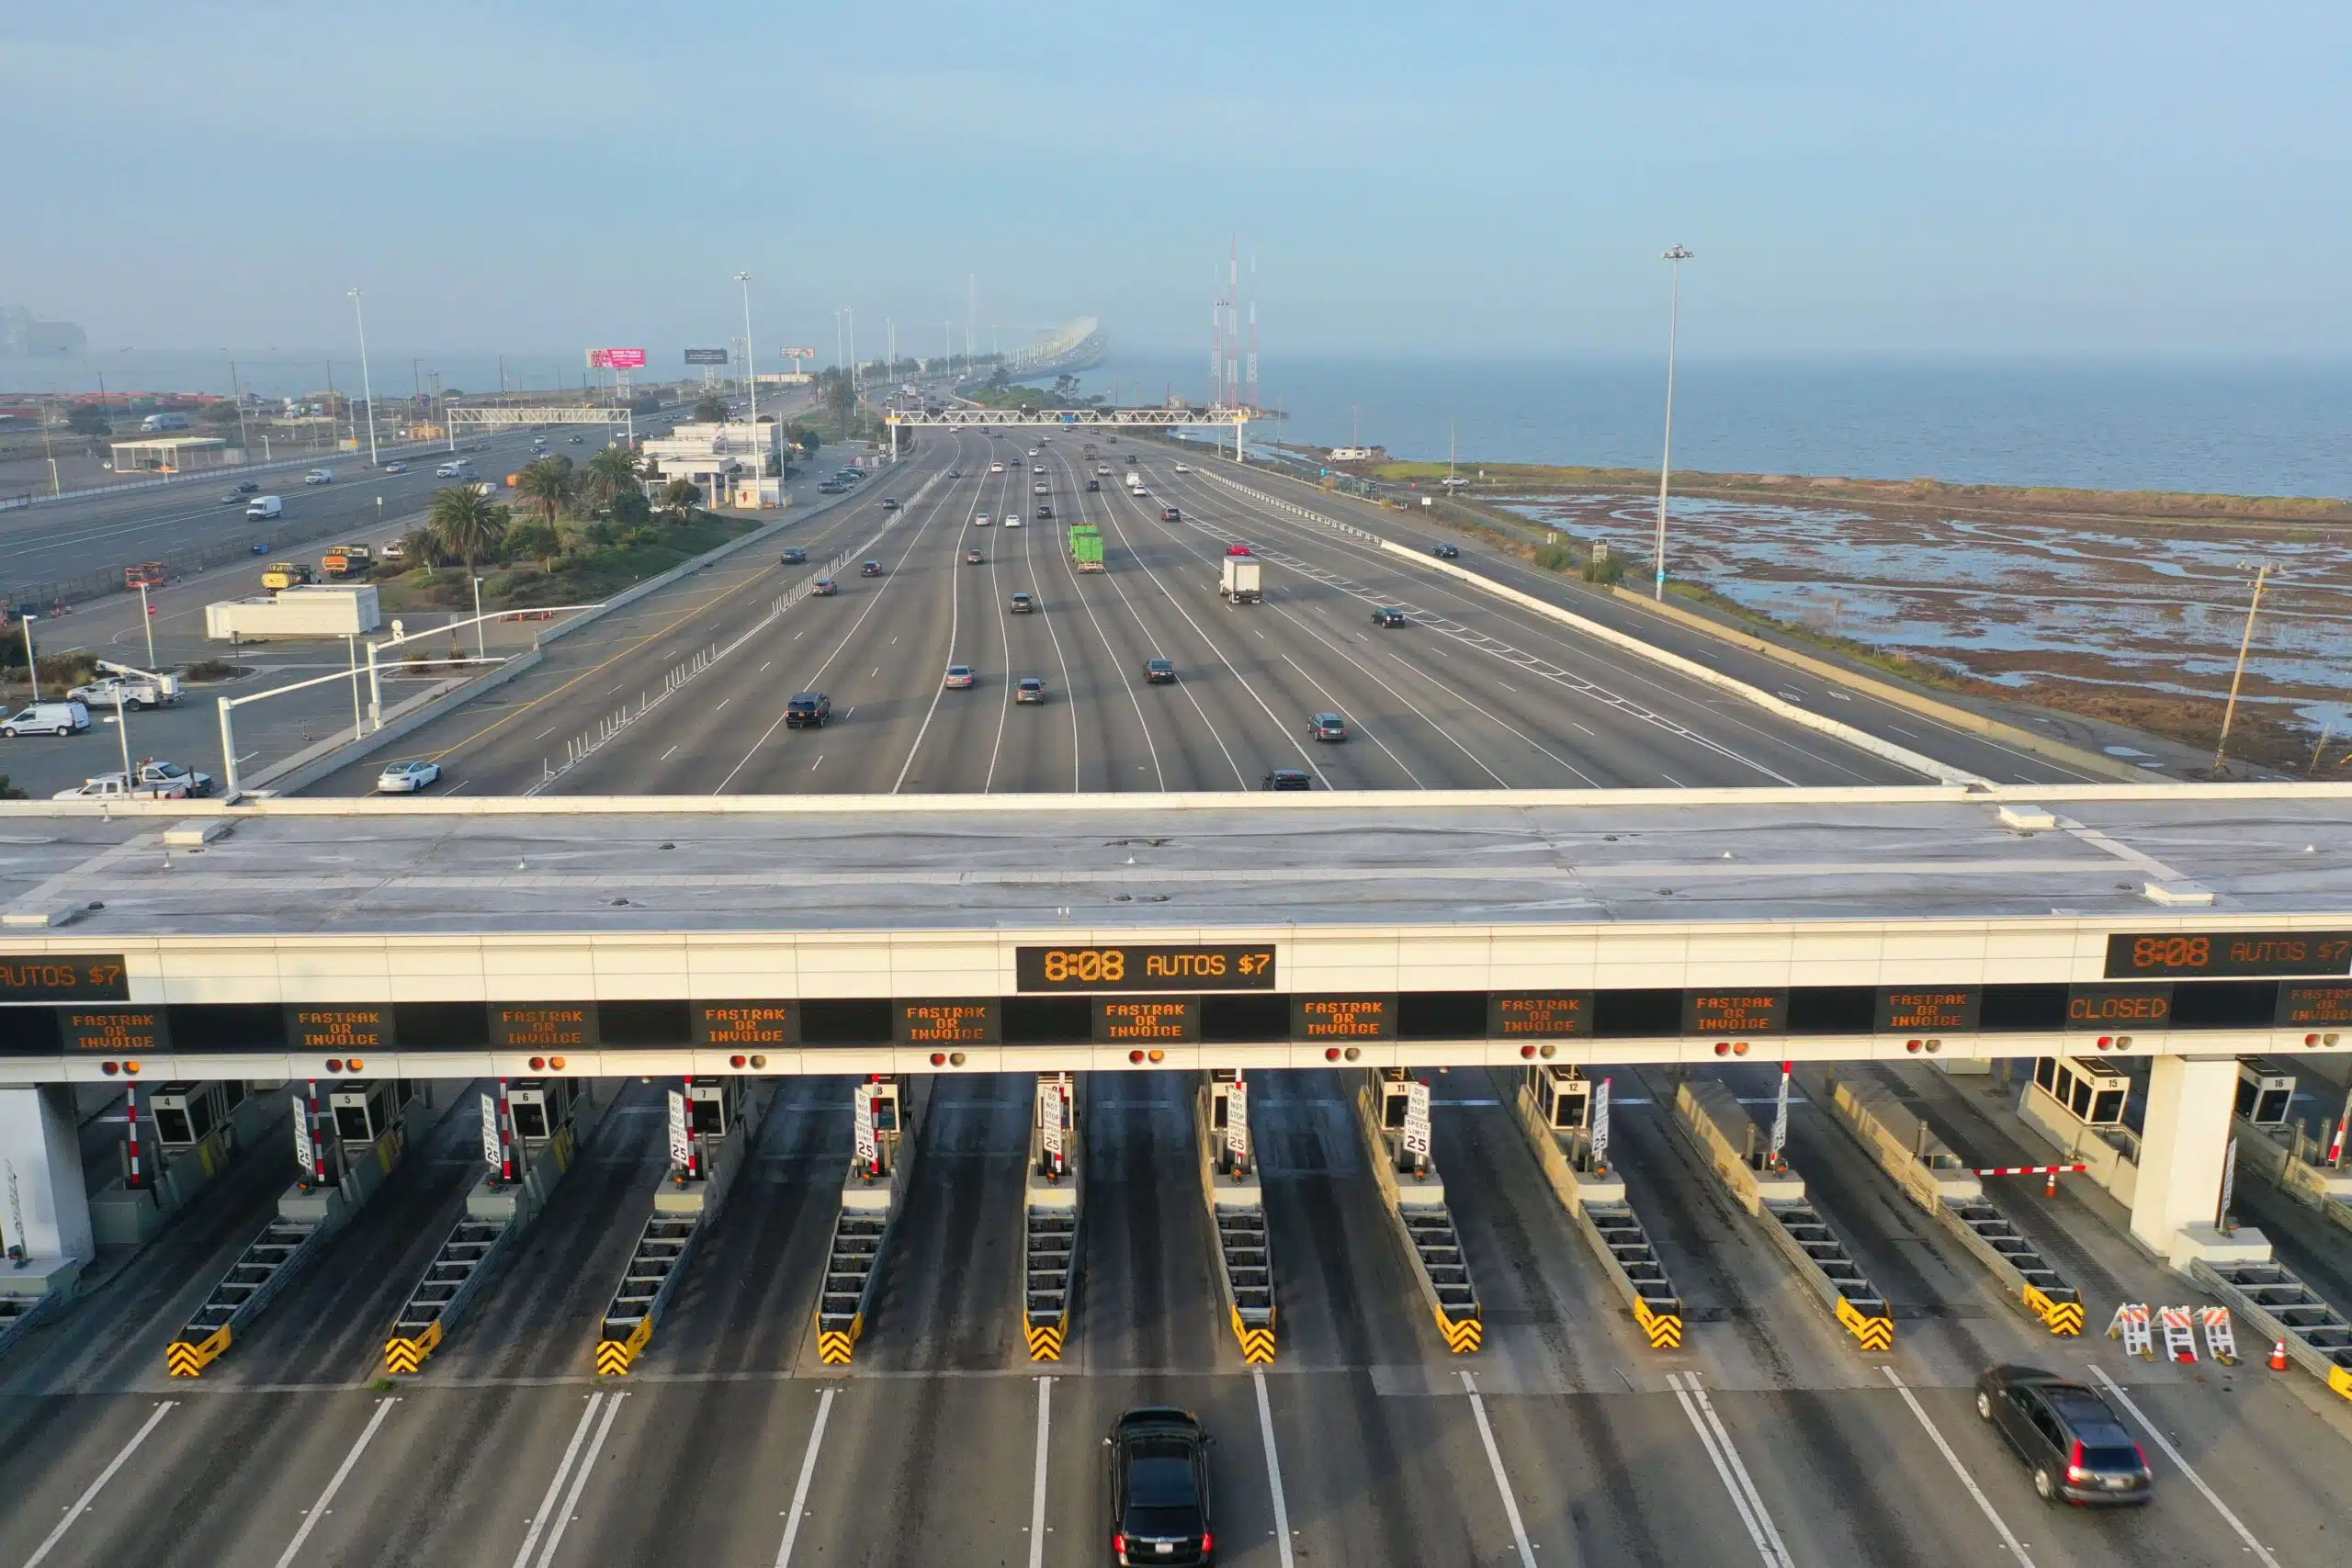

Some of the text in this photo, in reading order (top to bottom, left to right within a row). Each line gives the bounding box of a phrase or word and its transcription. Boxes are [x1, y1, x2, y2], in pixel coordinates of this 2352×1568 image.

[2133, 937, 2349, 966] 8:08 AUTOS $7
[1045, 950, 1271, 981] 8:08 AUTOS $7
[89, 965, 119, 985] $7
[1501, 999, 1578, 1010] FASTRAK
[1696, 998, 1773, 1008] FASTRAK
[1891, 996, 1966, 1005] FASTRAK
[2316, 1000, 2337, 1010] OR
[906, 1007, 985, 1018] FASTRAK
[1106, 1005, 1185, 1016] FASTRAK
[1303, 1002, 1384, 1013] FASTRAK
[1917, 1005, 1939, 1015] OR
[2070, 998, 2168, 1019] CLOSED
[300, 1013, 379, 1023] FASTRAK
[503, 1011, 582, 1021] FASTRAK
[706, 1009, 785, 1020] FASTRAK
[1332, 1013, 1355, 1023] OR
[1529, 1010, 1552, 1021] OR
[1724, 1008, 1746, 1018] OR
[73, 1015, 153, 1026] FASTRAK
[935, 1018, 957, 1029] OR
[1135, 1016, 1158, 1026] OR
[1700, 1018, 1768, 1029] INVOICE
[1893, 1015, 1959, 1025] INVOICE
[330, 1023, 353, 1034] OR
[533, 1021, 555, 1032] OR
[735, 1020, 757, 1031] OR
[1308, 1023, 1380, 1034] INVOICE
[1505, 1021, 1573, 1031] INVOICE
[105, 1026, 127, 1036] OR
[911, 1029, 981, 1040] INVOICE
[1110, 1026, 1182, 1036] INVOICE
[80, 1036, 153, 1047] INVOICE
[307, 1034, 377, 1044] INVOICE
[509, 1032, 581, 1043] INVOICE
[709, 1031, 783, 1042] INVOICE
[1396, 1084, 1405, 1092] 11
[1568, 1083, 1578, 1091] 12
[2109, 1078, 2118, 1088] 15
[2274, 1078, 2284, 1088] 16
[522, 1092, 529, 1101] 6
[701, 1089, 707, 1099] 7
[1047, 1092, 1057, 1100] DO
[1233, 1092, 1242, 1100] DO
[1415, 1088, 1424, 1096] DO
[164, 1098, 171, 1106] 4
[345, 1096, 351, 1104] 5
[858, 1094, 866, 1102] DO
[1411, 1097, 1425, 1106] NOT
[672, 1106, 682, 1114] NOT
[858, 1103, 868, 1111] NOT
[1046, 1102, 1057, 1111] NOT
[1230, 1102, 1242, 1111] NOT
[1410, 1106, 1426, 1115] STOP
[671, 1114, 684, 1124] STOP
[857, 1111, 869, 1121] STOP
[1046, 1111, 1058, 1121] STOP
[1229, 1111, 1244, 1120] STOP
[1046, 1125, 1060, 1134] SPEED
[1229, 1124, 1244, 1134] SPEED
[1408, 1119, 1428, 1130] SPEED
[671, 1128, 685, 1139] SPEED
[856, 1125, 873, 1137] SPEED
[1408, 1127, 1426, 1137] LIMIT
[858, 1134, 872, 1143] LIMIT
[1046, 1137, 1059, 1150] 25
[1229, 1136, 1244, 1150] 25
[1408, 1135, 1426, 1152] 25
[1594, 1134, 1606, 1151] 25
[673, 1145, 687, 1161] 25
[858, 1142, 873, 1157] 25
[300, 1149, 311, 1166] 25
[487, 1146, 500, 1164] 25
